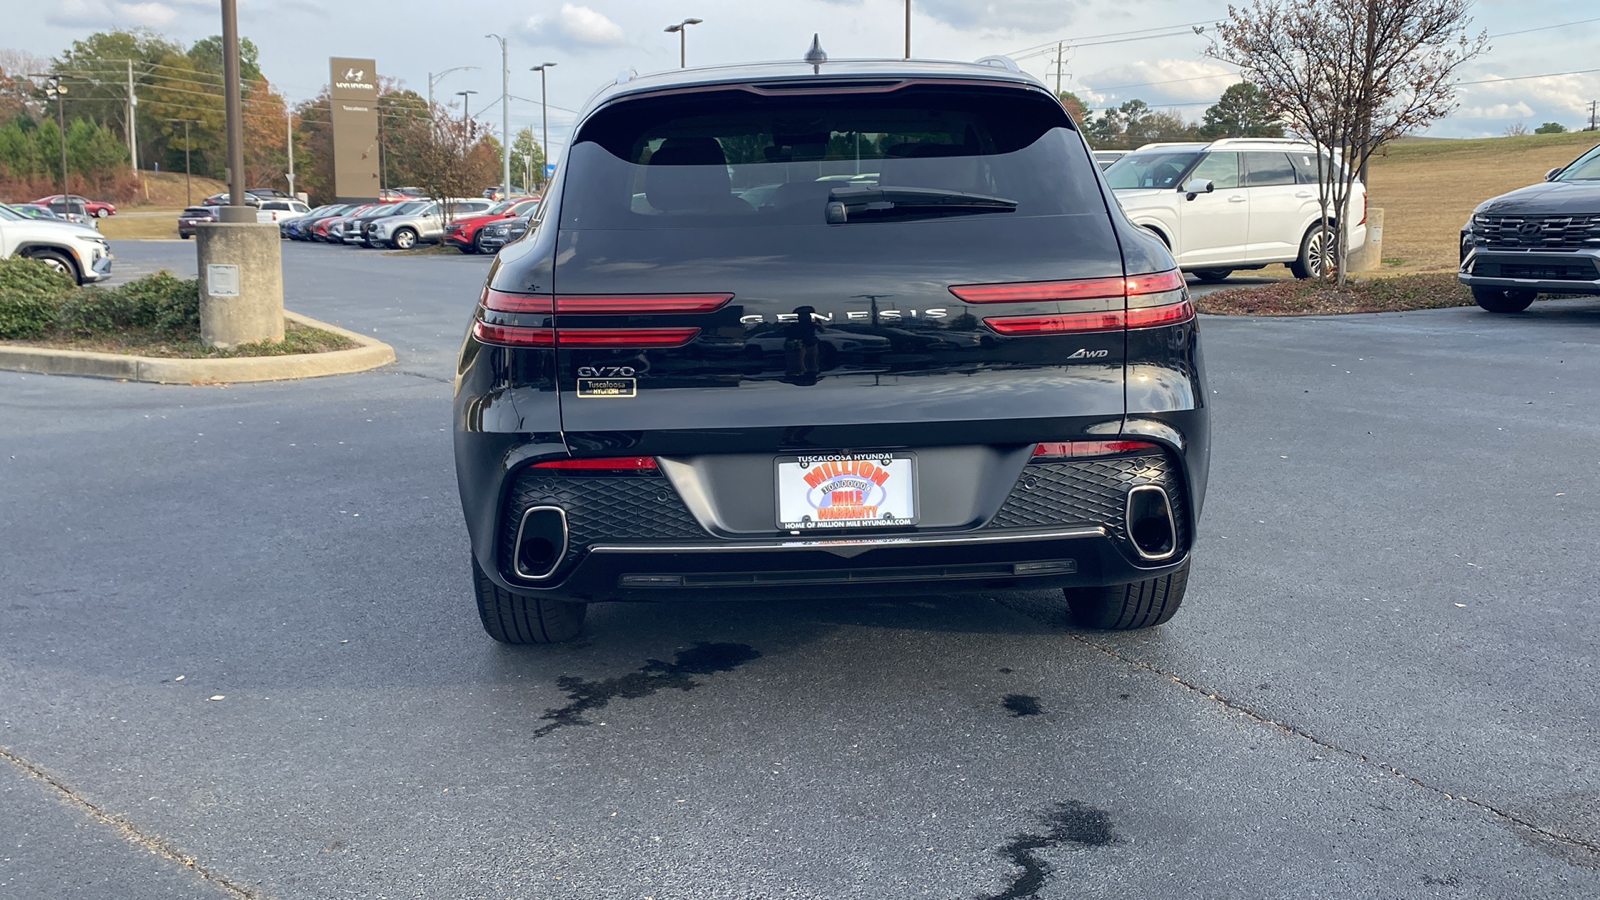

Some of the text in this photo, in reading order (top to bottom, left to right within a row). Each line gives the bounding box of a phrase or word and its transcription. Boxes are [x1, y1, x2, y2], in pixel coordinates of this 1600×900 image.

[739, 308, 948, 324] GENESIS
[1066, 348, 1109, 360] AWD
[577, 366, 636, 377] GV70
[587, 380, 626, 389] Tuscaloosa
[803, 460, 890, 489] MILLION
[832, 490, 863, 507] MILE
[817, 506, 878, 520] WARRANTY
[817, 520, 845, 528] MILLION
[845, 520, 861, 528] MILE
